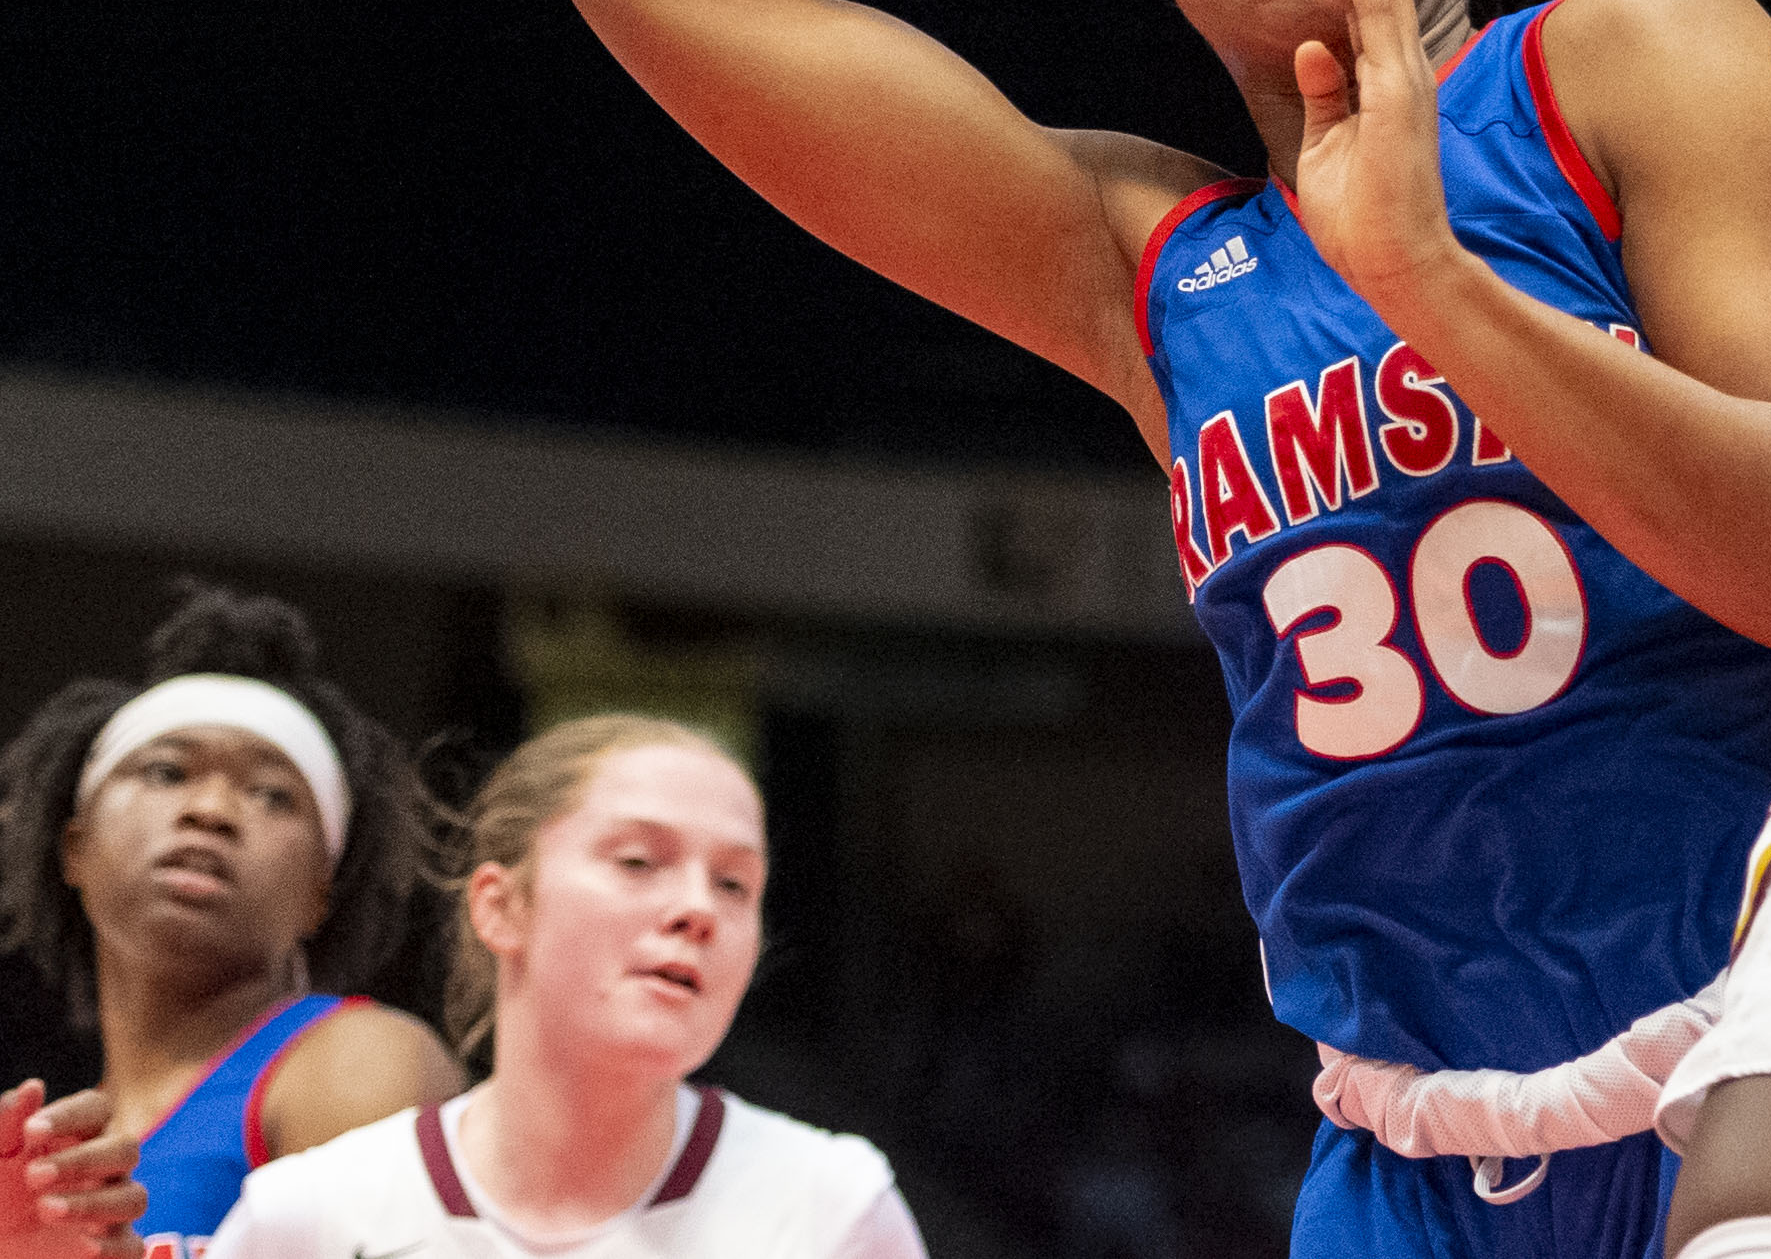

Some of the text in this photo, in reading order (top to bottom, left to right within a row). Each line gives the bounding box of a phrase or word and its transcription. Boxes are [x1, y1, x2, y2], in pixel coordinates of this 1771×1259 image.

[1177, 256, 1259, 293] adidas
[1169, 323, 1640, 605] RAMS
[1262, 496, 1589, 762] 30
